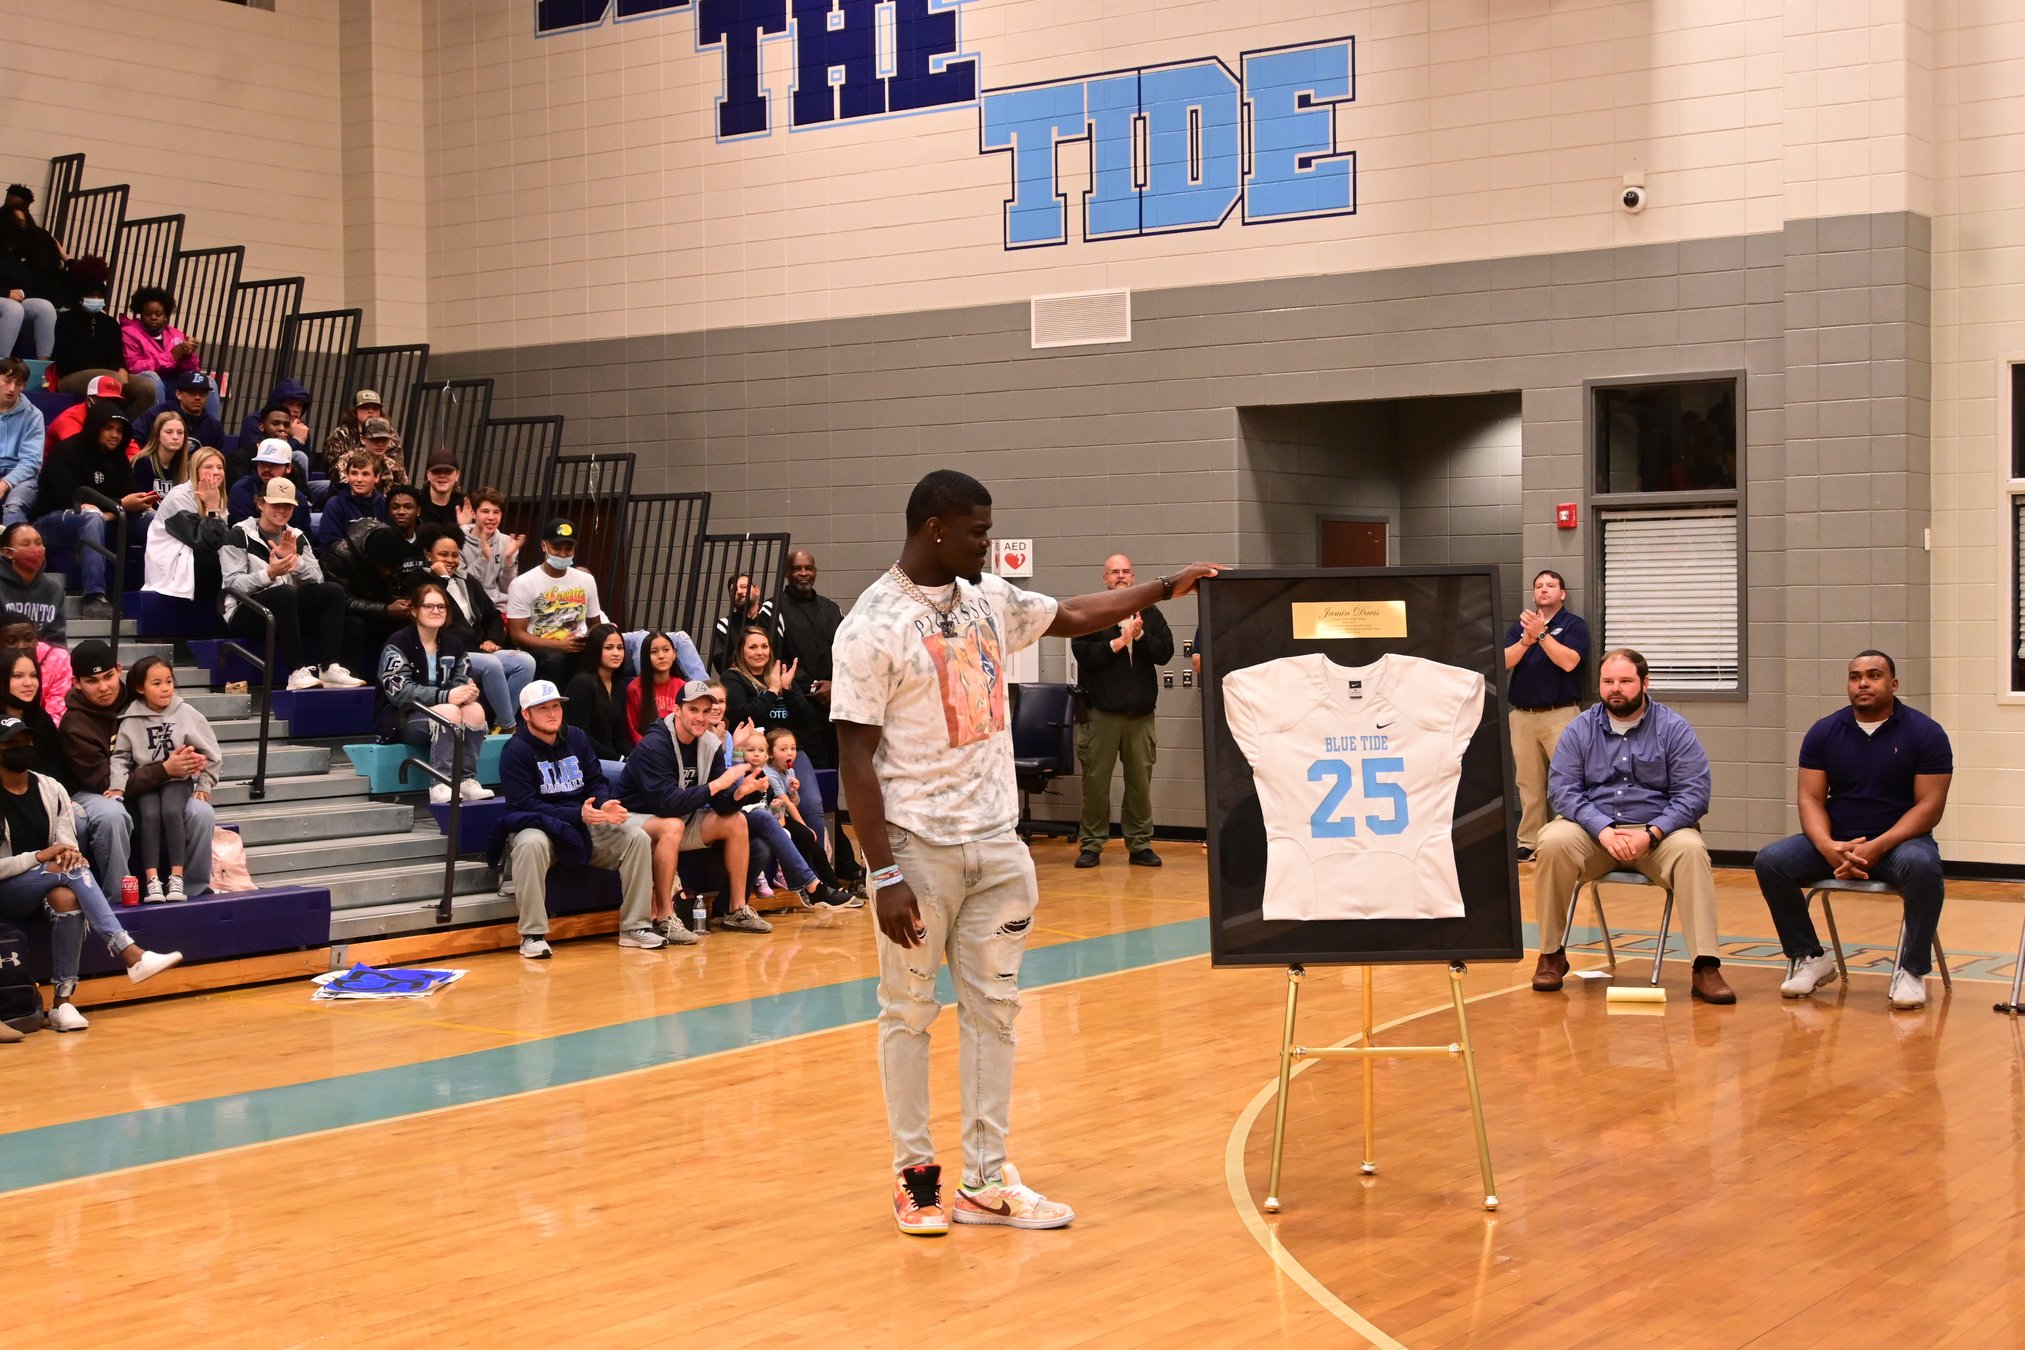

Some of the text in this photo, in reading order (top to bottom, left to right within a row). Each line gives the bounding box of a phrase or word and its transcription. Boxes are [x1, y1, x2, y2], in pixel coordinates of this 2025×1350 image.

[695, 0, 981, 144] THE
[979, 35, 1357, 251] TIDE
[1004, 542, 1027, 551] AED
[1325, 735, 1388, 752] BLUE TIDE
[1307, 757, 1409, 838] 25
